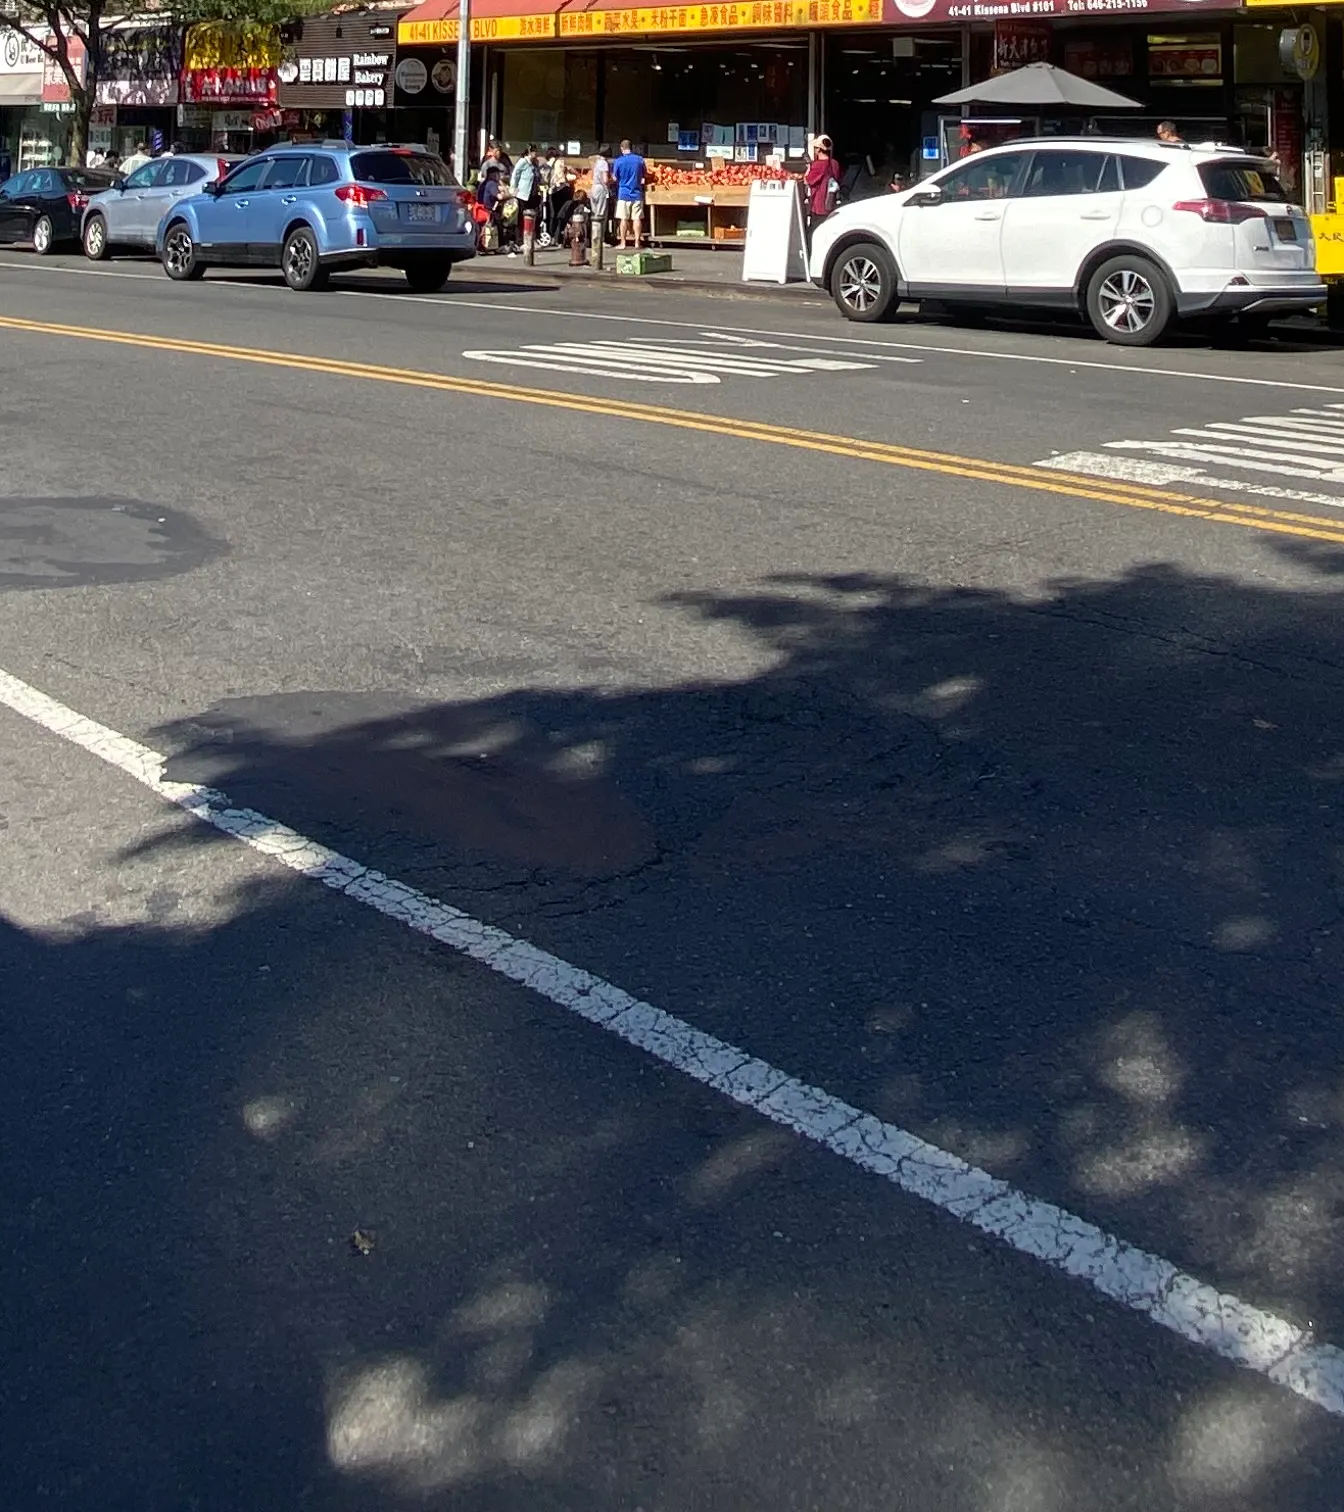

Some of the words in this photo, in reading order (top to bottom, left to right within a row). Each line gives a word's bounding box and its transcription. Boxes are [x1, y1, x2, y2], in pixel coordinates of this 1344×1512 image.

[948, 5, 972, 17] 41-41
[974, 3, 1009, 16] Kissena
[1011, 1, 1031, 14] Blvd
[1032, 0, 1055, 13] #101
[409, 24, 431, 41] 41-41
[432, 21, 460, 40] KISSE
[473, 19, 498, 38] BLVD
[353, 53, 389, 66] Rainbow
[355, 70, 385, 86] Bakery
